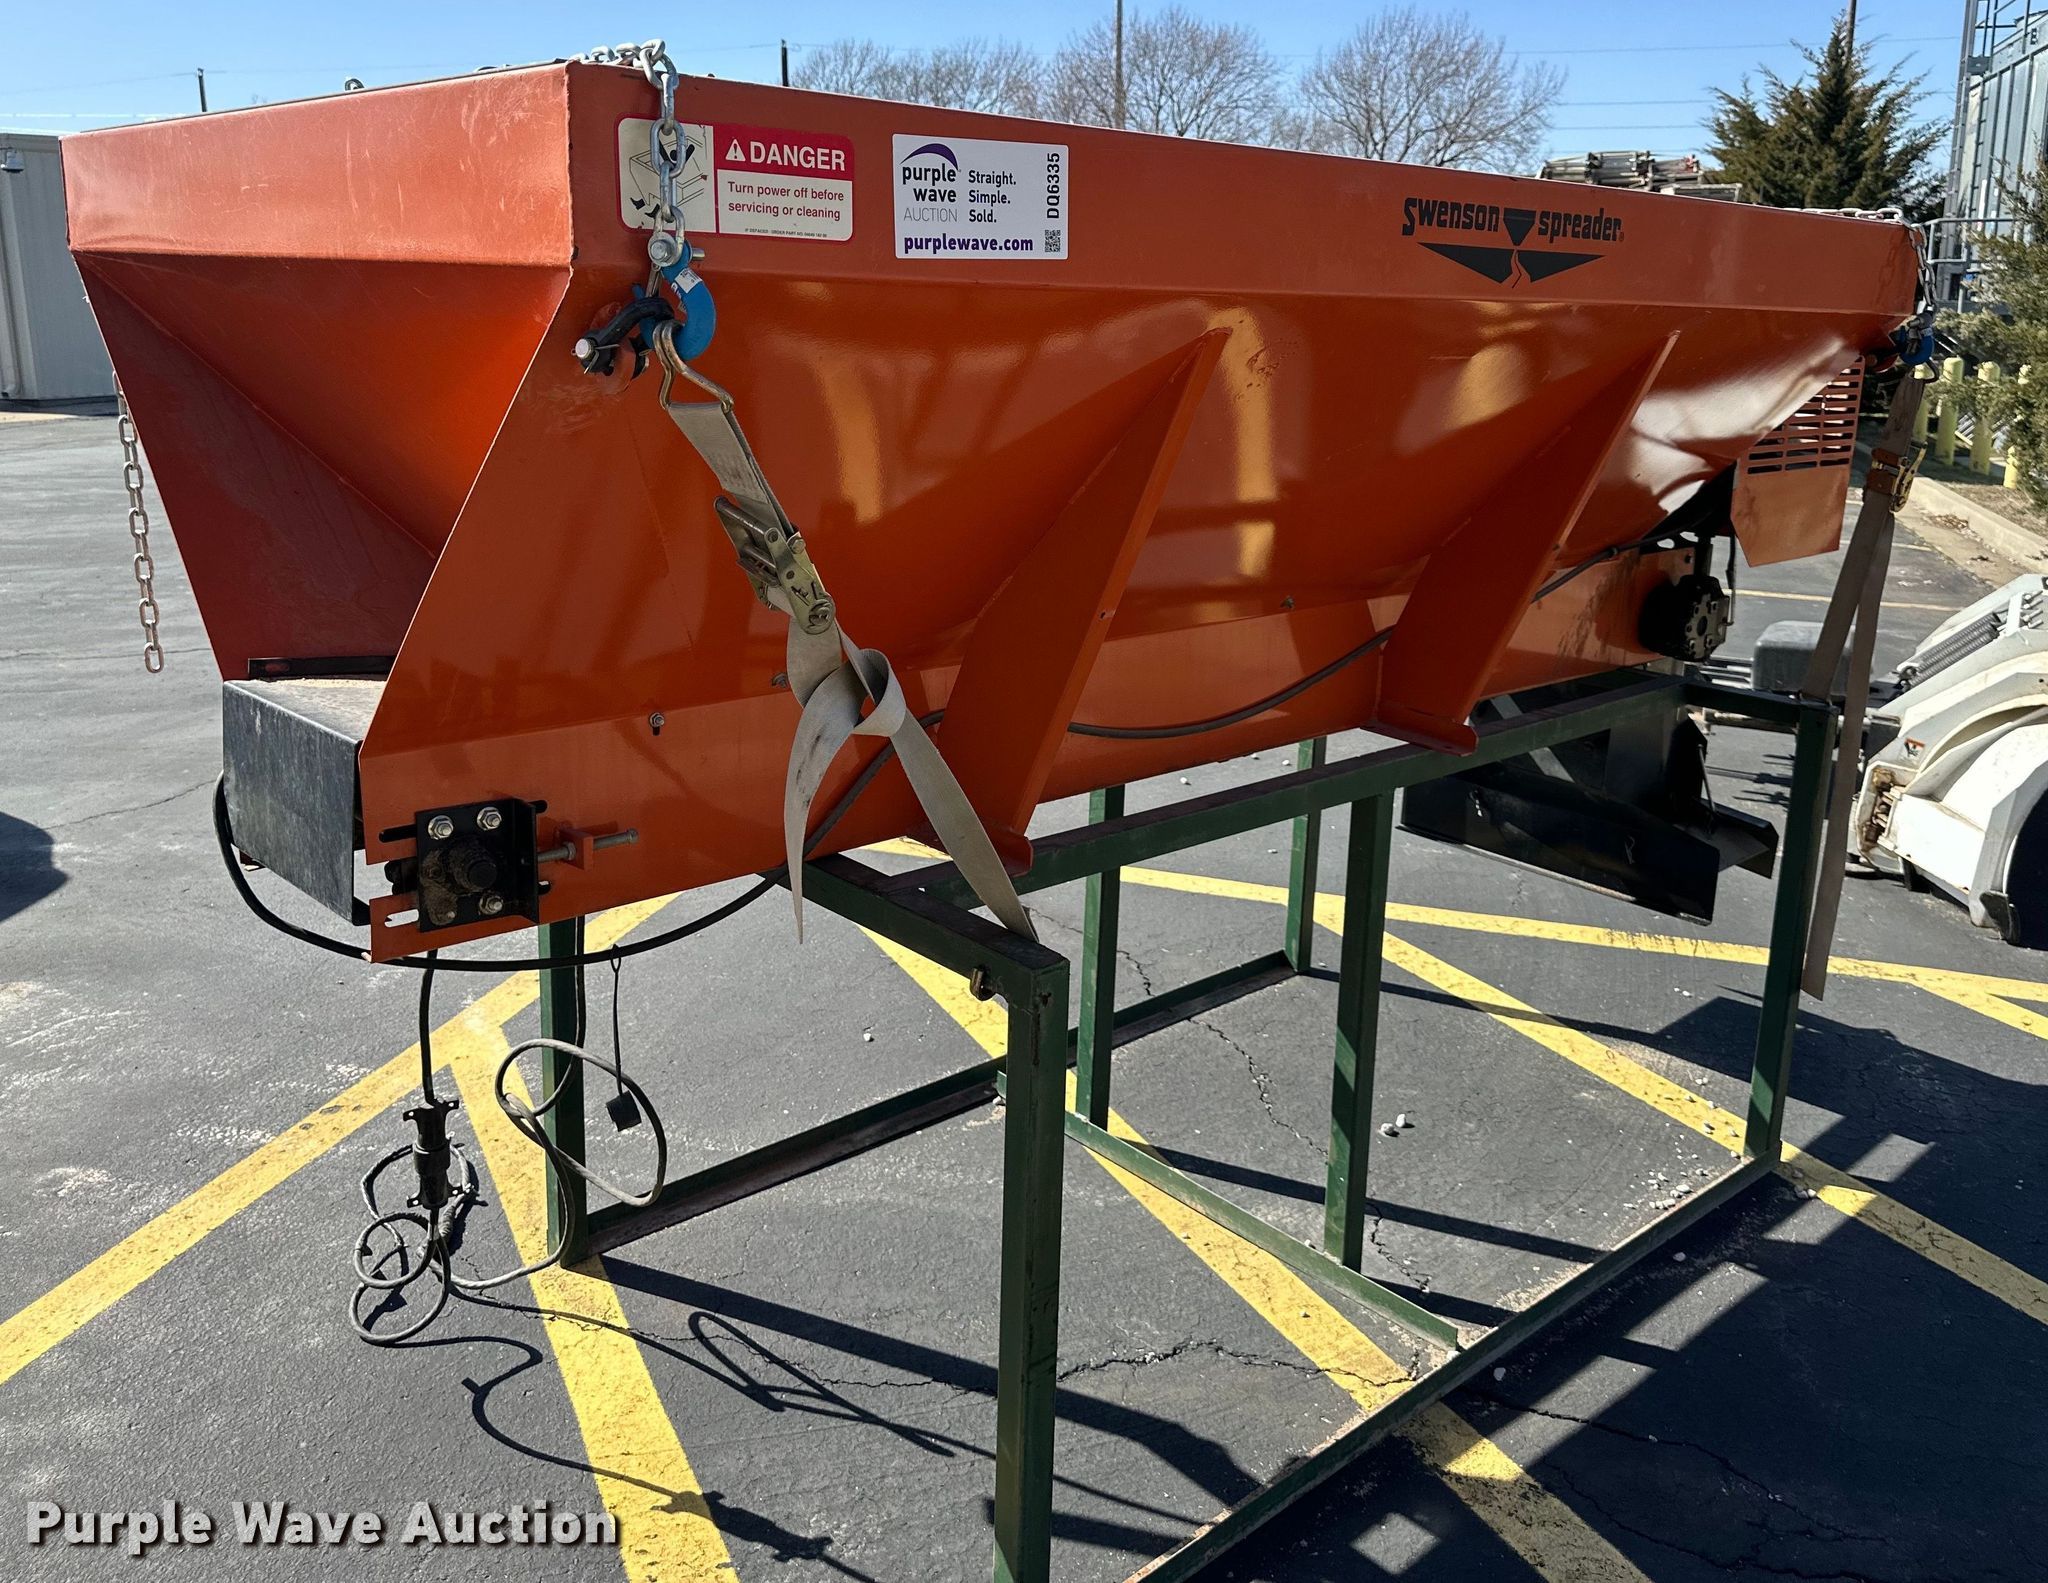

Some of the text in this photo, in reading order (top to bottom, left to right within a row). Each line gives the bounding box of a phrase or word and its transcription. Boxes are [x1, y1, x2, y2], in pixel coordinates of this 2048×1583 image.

[750, 140, 845, 171] DANGER
[902, 163, 957, 186] purple
[968, 169, 1017, 188] Straight.
[727, 181, 844, 201] Turn power off before
[913, 187, 957, 203] wave
[1046, 152, 1060, 219] DQ6335
[968, 190, 1011, 207] Simple.
[728, 202, 841, 221] servicing or cleaning
[903, 207, 958, 222] AUCTION
[968, 209, 998, 223] Sold.
[1402, 197, 1623, 244] Swenson spreader
[904, 233, 1034, 254] purplewave.com
